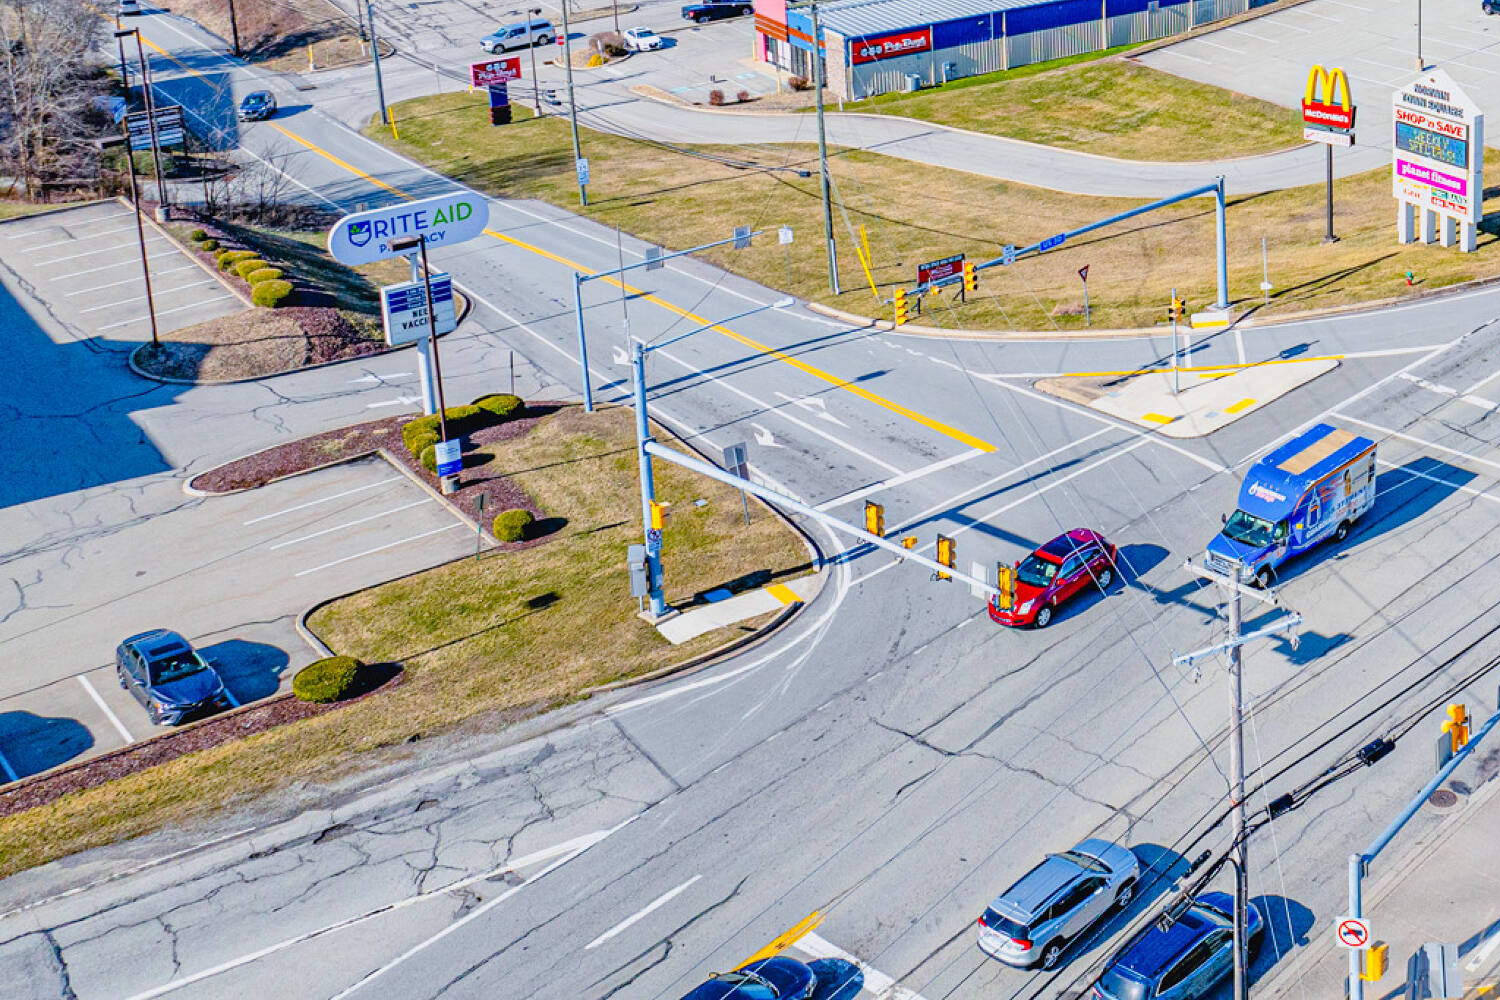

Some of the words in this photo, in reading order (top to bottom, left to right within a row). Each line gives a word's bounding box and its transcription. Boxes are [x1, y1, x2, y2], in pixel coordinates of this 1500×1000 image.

[1304, 108, 1349, 123] McDonald's
[1396, 108, 1426, 125] SHOP
[1436, 121, 1465, 138] SAVE
[1401, 162, 1431, 181] planet
[1431, 171, 1462, 191] fitness
[374, 210, 429, 239] RITE
[432, 202, 473, 227] AID
[379, 230, 446, 253] PACY
[402, 315, 439, 330] VACCIE
